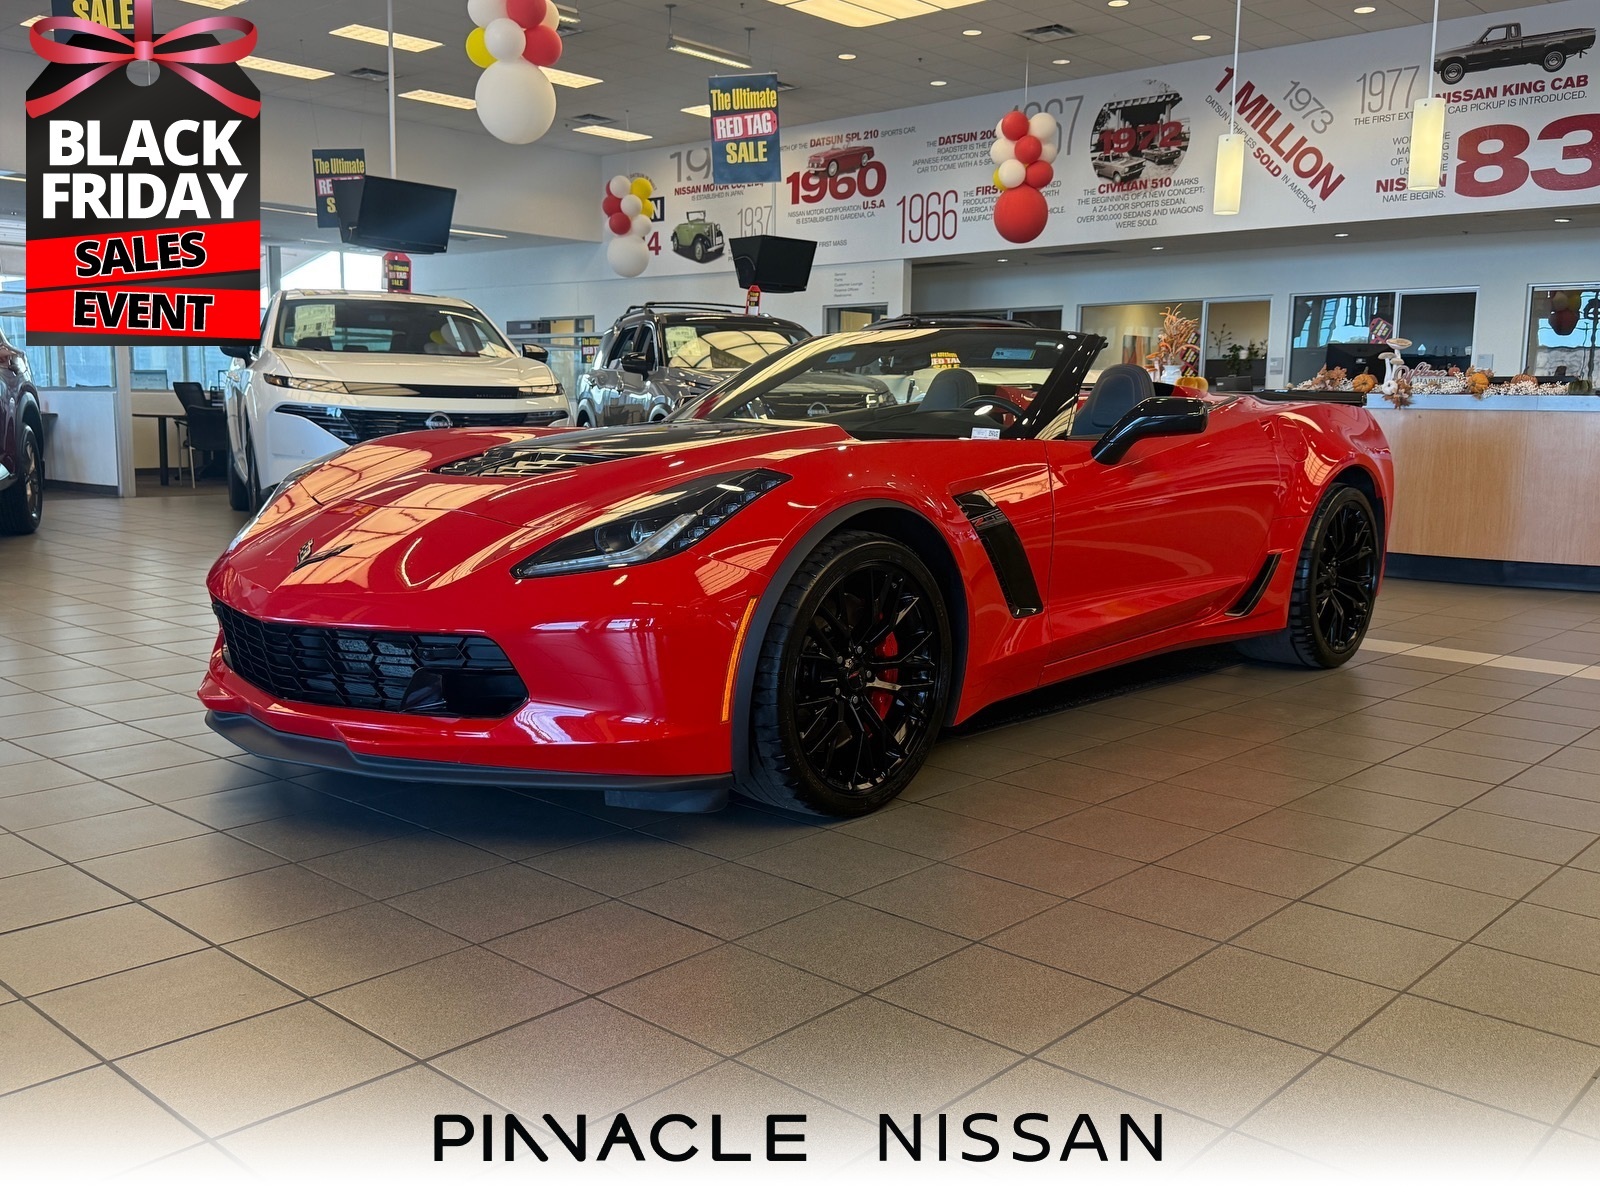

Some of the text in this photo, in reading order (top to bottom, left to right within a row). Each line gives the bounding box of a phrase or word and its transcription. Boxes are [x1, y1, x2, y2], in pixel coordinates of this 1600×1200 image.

[1356, 65, 1420, 114] 1977
[1502, 80, 1546, 97] KING
[1550, 74, 1589, 91] CAB
[710, 88, 777, 111] The Ultimate
[1283, 80, 1334, 134] 1973
[1354, 117, 1371, 126] THE
[1372, 113, 1396, 123] FIRST
[1447, 104, 1468, 115] CAB
[1470, 100, 1506, 112] PICKUP
[1507, 98, 1517, 108] IS
[1518, 90, 1588, 106] INTRODUCED.
[716, 112, 772, 139] RED TAG
[809, 134, 844, 148] DATSUN
[845, 132, 863, 144] SPL
[863, 129, 880, 140] 210
[880, 129, 903, 138] SPORTS
[938, 131, 978, 147] DATSUN
[1098, 120, 1184, 155] 1972
[1204, 95, 1230, 121] DATSUN
[1253, 147, 1282, 177] SOLD
[1281, 174, 1291, 184] IN
[1229, 80, 1346, 201] MILLION
[726, 141, 768, 164] SALE
[936, 144, 968, 155] ROADSTER
[975, 141, 987, 149] THE
[314, 158, 365, 174] The Ultimate
[916, 165, 930, 174] CAR
[938, 162, 957, 171] COME
[957, 160, 973, 169] WITH
[318, 179, 334, 195] RE
[674, 184, 702, 196] NISSAN
[786, 160, 887, 205] 1960
[963, 190, 975, 198] THE
[975, 184, 1003, 196] FIRS
[1083, 176, 1200, 197] THE CIVILIAN 510 MARKS
[962, 196, 999, 206] PRODUCTIO
[1077, 198, 1091, 206] THE
[1091, 193, 1130, 205] BEGINNING
[1131, 192, 1141, 200] OF
[1148, 189, 1166, 200] NEW
[1130, 199, 1160, 210] SPORTS
[1382, 190, 1446, 203] NAME BEGINS.
[787, 210, 805, 218] NISSAN
[805, 208, 825, 216] MOTOR
[862, 199, 886, 210] U.S.A
[896, 190, 959, 245] 1966
[961, 213, 994, 223] MANUFACT
[962, 205, 988, 215] AMERICA
[1076, 216, 1096, 224] OVER
[1123, 209, 1152, 220] SEDANS
[1152, 209, 1169, 218] AND
[1169, 204, 1205, 216] WAGONS
[1115, 221, 1137, 229] WERE
[832, 239, 848, 247] MASS
